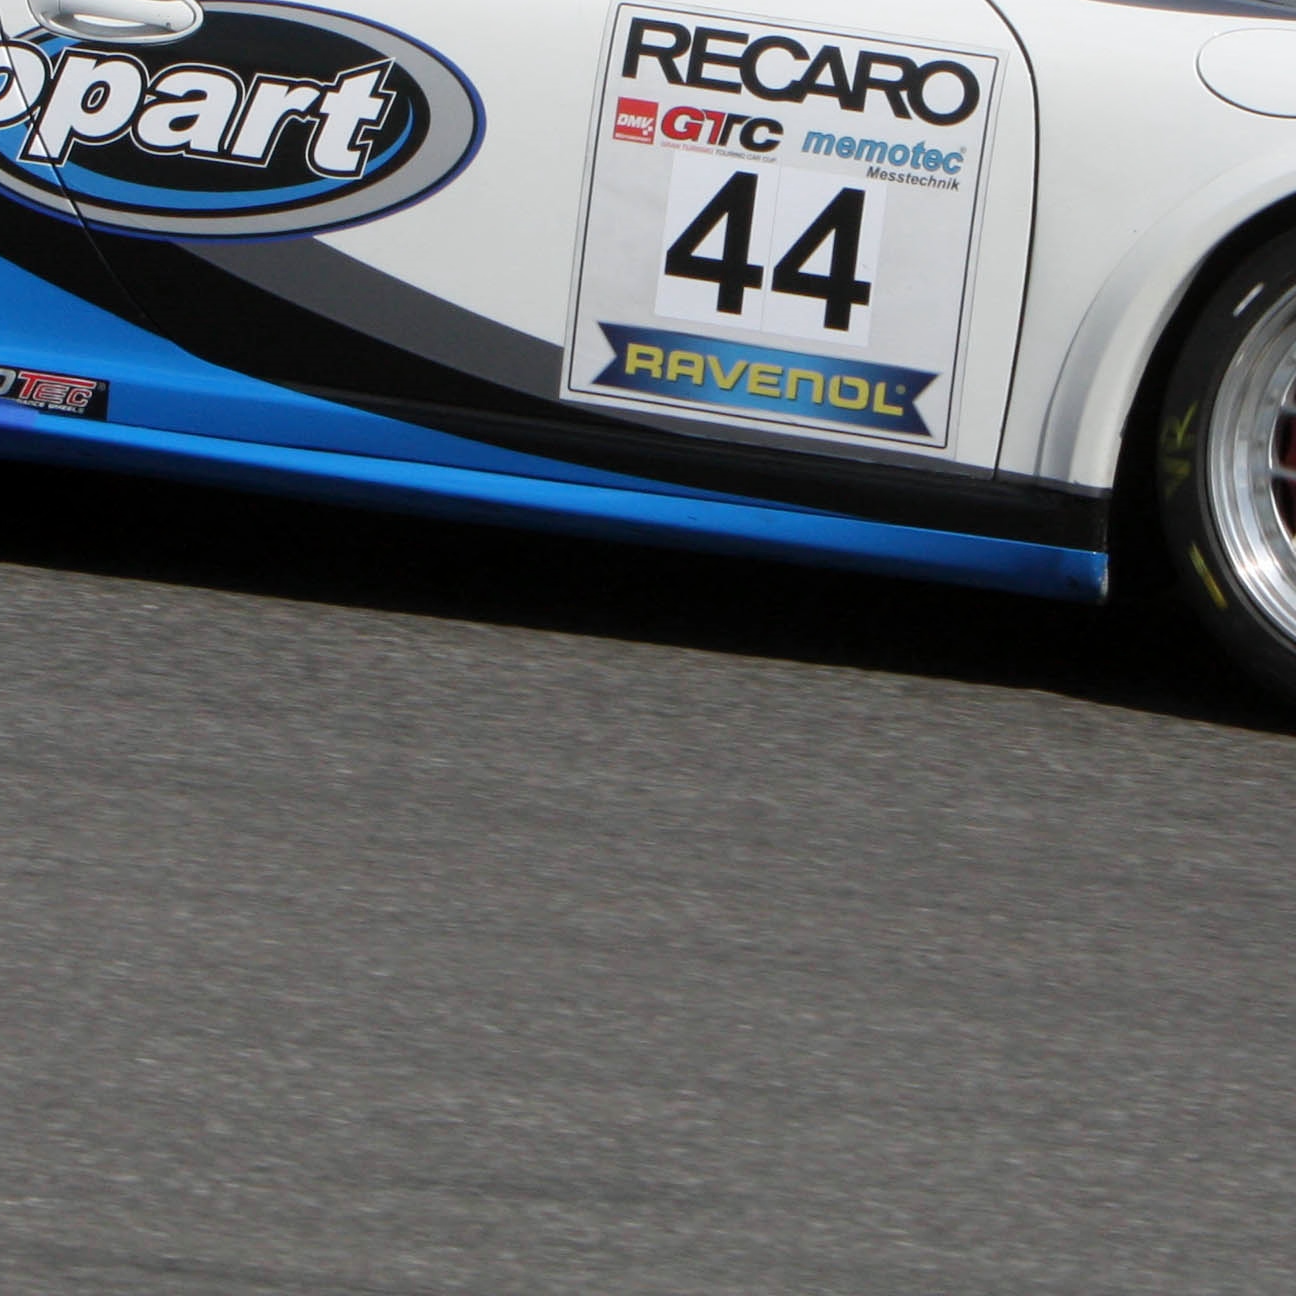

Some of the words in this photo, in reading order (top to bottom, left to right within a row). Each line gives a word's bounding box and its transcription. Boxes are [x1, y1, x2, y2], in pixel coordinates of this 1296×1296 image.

[621, 17, 980, 127] RECARO
[617, 114, 654, 129] DMV
[801, 128, 965, 176] memotec
[866, 165, 961, 192] Messtechnik
[664, 171, 872, 332] 44
[623, 342, 905, 417] RAVENOL
